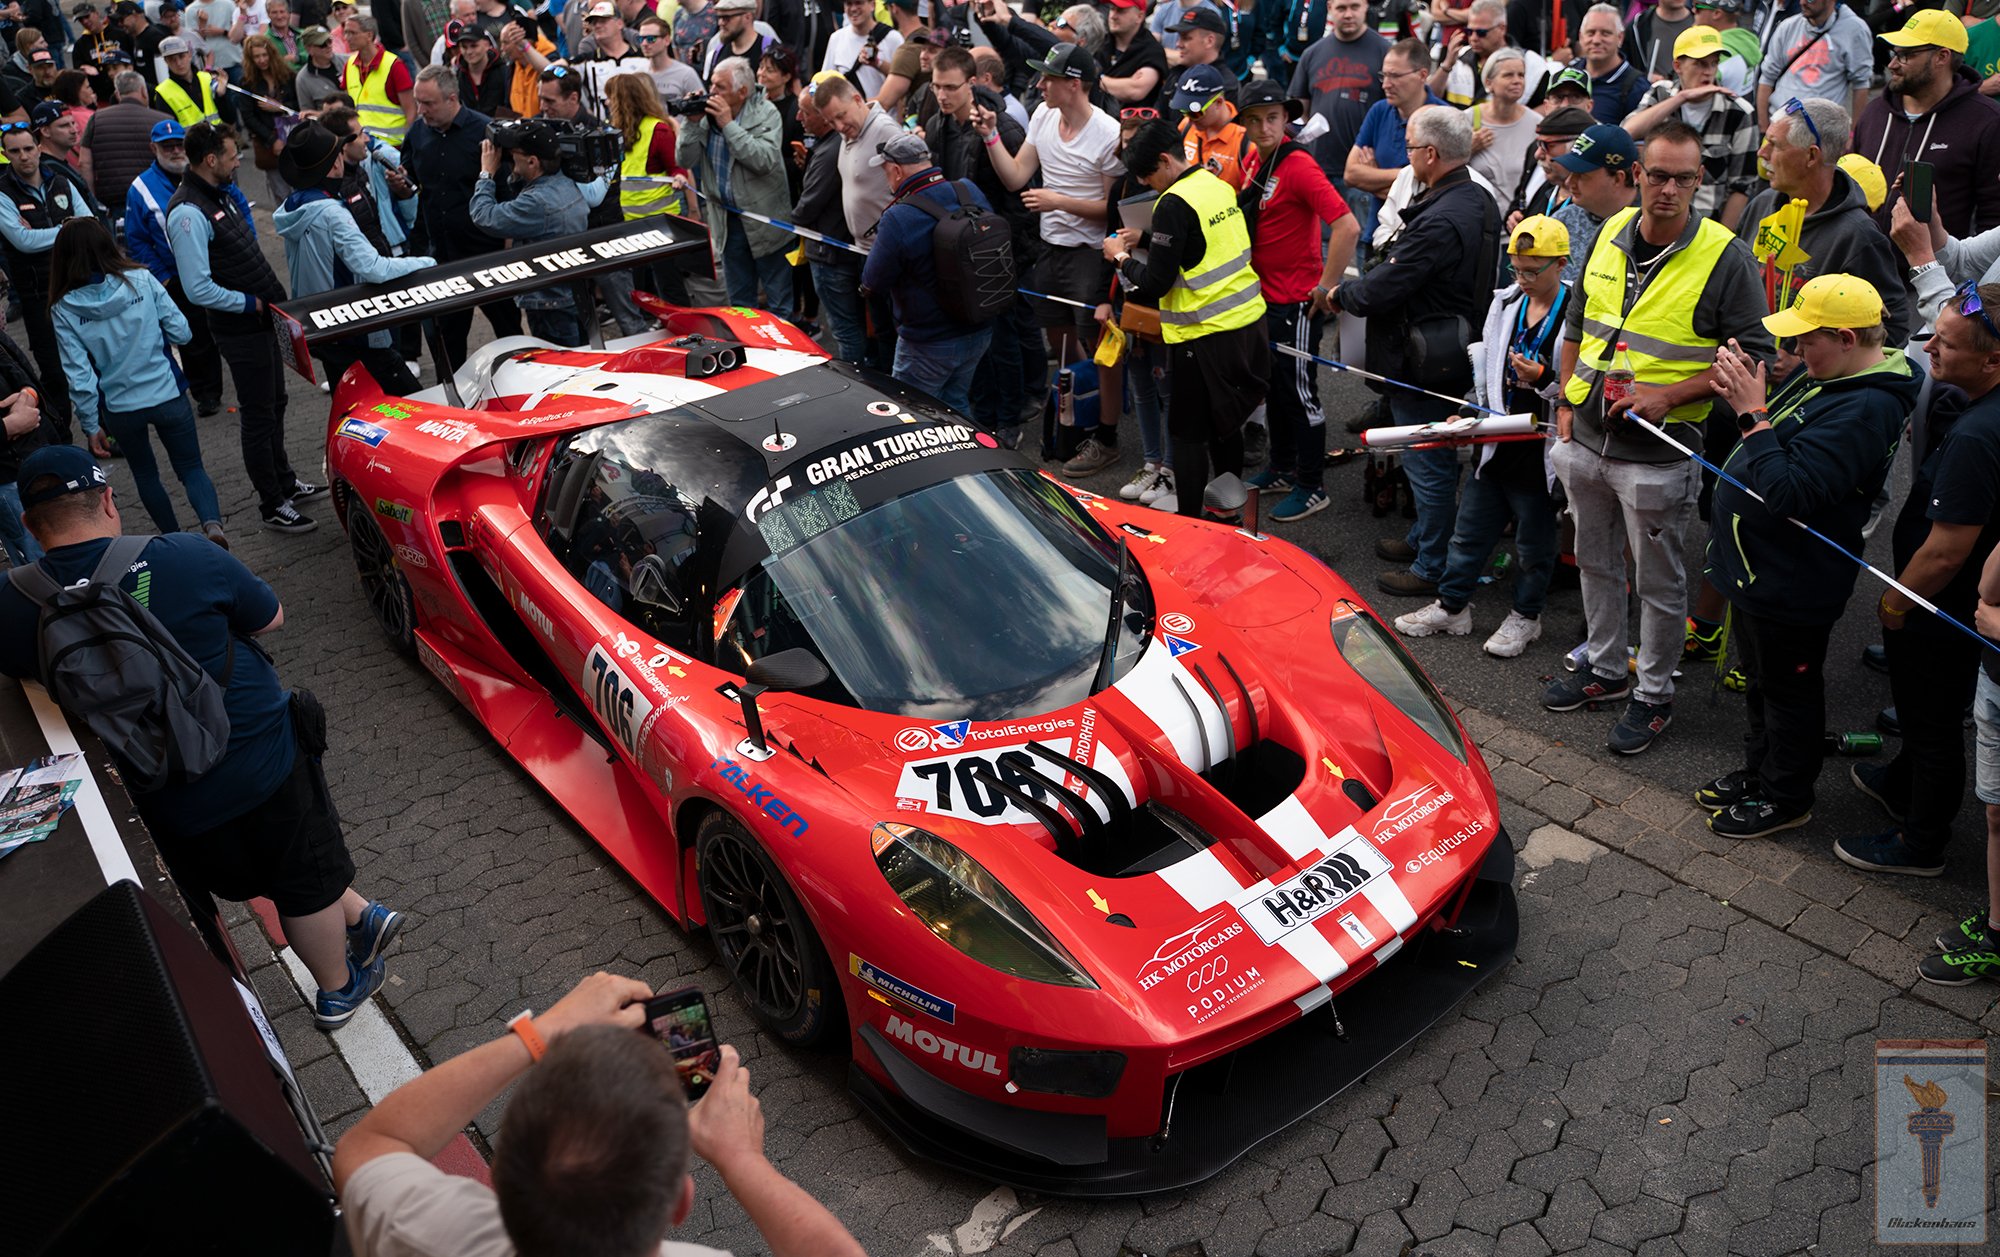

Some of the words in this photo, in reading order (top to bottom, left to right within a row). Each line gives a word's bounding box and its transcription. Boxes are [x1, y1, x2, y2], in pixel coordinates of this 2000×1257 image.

[1208, 211, 1226, 227] MSC
[310, 276, 475, 329] RACECARS
[472, 262, 537, 288] FOR
[533, 247, 596, 273] THE
[591, 230, 674, 257] ROAD
[415, 419, 469, 444] MANTA
[806, 449, 875, 486] GRAN
[872, 424, 971, 459] TURISMO
[844, 466, 875, 483] REAL
[874, 451, 920, 472] DRIVING
[920, 441, 978, 458] SIMULATOR
[378, 501, 410, 522] Sabelt
[519, 592, 556, 642] MOTUL
[630, 652, 672, 699] TotalEnergies
[592, 651, 634, 758] 706
[969, 717, 1076, 741] TotalEnergies
[1078, 707, 1097, 766] ORDRHEIN
[710, 756, 809, 839] FALKEN
[911, 750, 1048, 818] 706
[1374, 827, 1396, 845] HK
[1394, 789, 1454, 838] MOTORCARS
[1420, 820, 1483, 866] Equitus.us
[1263, 869, 1339, 926] H&R
[1138, 970, 1165, 991] HK
[1161, 921, 1244, 977] MOTORCARS
[876, 976, 942, 1013] MICHELIN
[1187, 966, 1261, 1018] PODIUM
[1197, 1003, 1226, 1025] ADVANCED
[1226, 978, 1266, 1005] TECHNOLOGIES
[885, 1014, 1002, 1076] MOTUL
